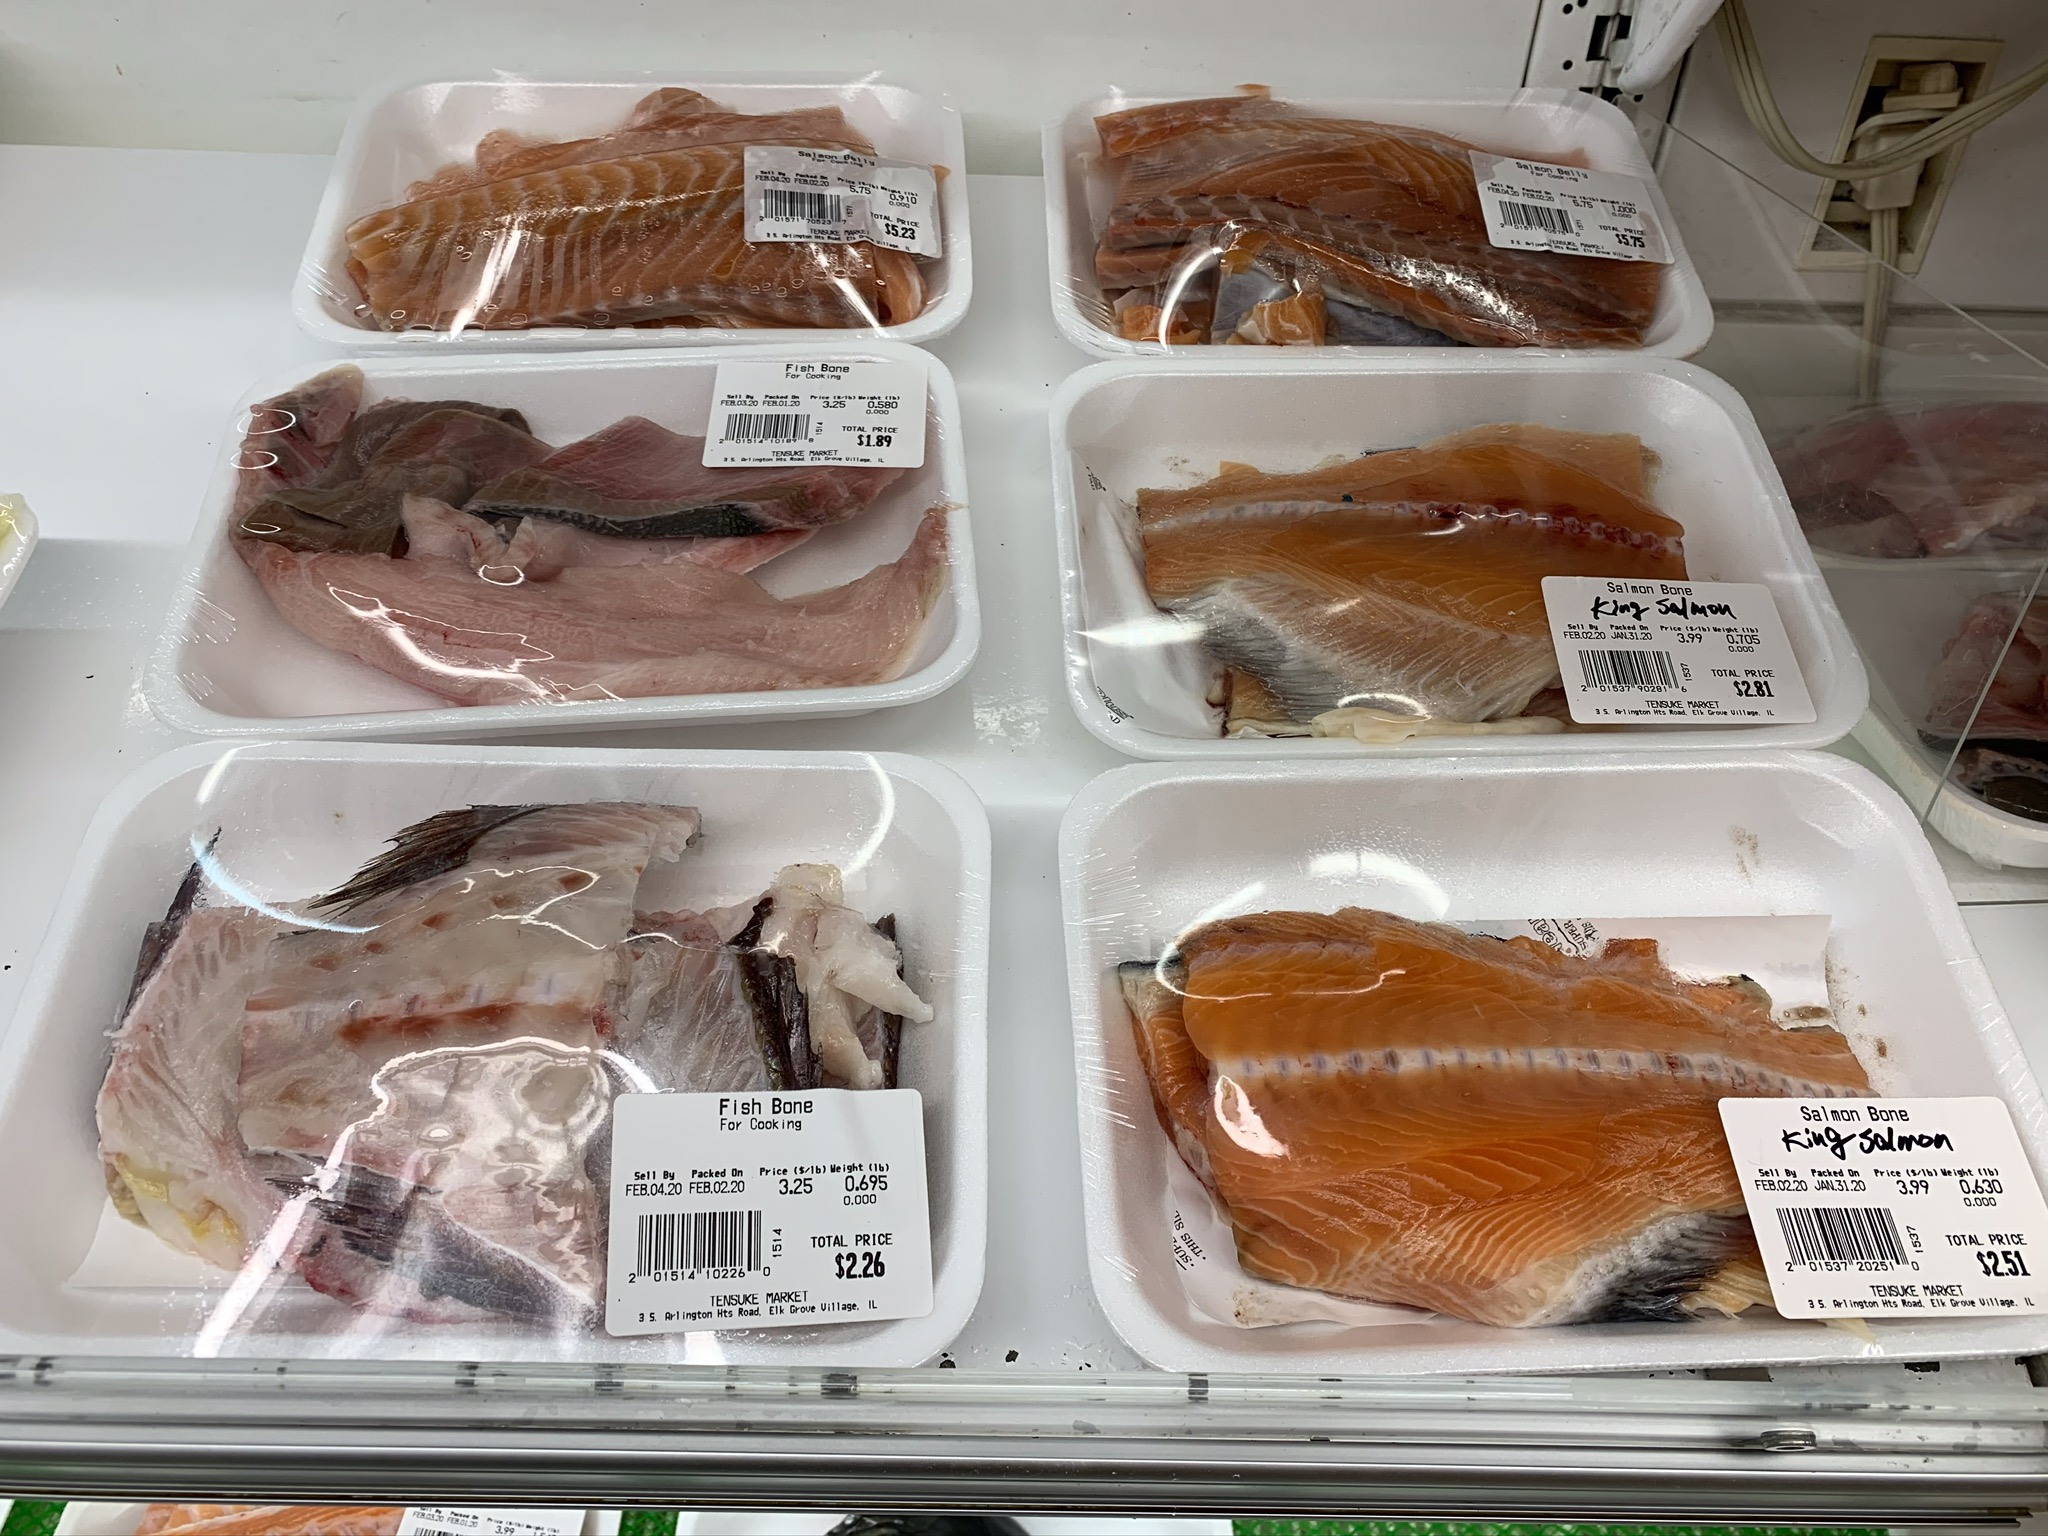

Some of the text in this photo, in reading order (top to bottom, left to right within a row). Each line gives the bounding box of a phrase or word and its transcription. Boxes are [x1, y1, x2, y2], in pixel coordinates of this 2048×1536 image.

[798, 151, 875, 166] Salmon Belly
[1516, 162, 1588, 179] Salmon Belly
[849, 185, 871, 195] 5.75
[889, 194, 917, 205] 0.910
[1572, 200, 1593, 209] 5.75
[1611, 205, 1637, 214] 1.000
[870, 211, 919, 228] TOTAL PRICE
[885, 222, 916, 240] $5.23
[1599, 225, 1647, 236] TOTAL PRICE
[1615, 233, 1646, 248] $5.75
[785, 363, 850, 373] Fish Bone
[822, 400, 846, 408] 3.25
[867, 401, 898, 409] 0.580
[857, 434, 892, 447] $1.89
[1607, 582, 1693, 596] Salmon Bone
[1563, 631, 1653, 640] FEB.02.20 JAN.31.20
[1677, 633, 1702, 643] 3.99
[1726, 634, 1761, 645] 0.705
[1728, 645, 1754, 653] 0.000
[1680, 663, 1692, 681] 1537
[1711, 669, 1775, 678] TOTAL PRICE
[1637, 685, 1667, 693] 90281
[1733, 680, 1775, 697] $2.81
[1645, 700, 1719, 709] TENSUKE MARKET
[719, 1097, 813, 1116] Fish Bone
[1800, 1106, 1909, 1122] Salmon Bone
[720, 1117, 802, 1131] For Cooking
[634, 1171, 656, 1181] Sell
[663, 1170, 675, 1181] By
[692, 1168, 726, 1178] Packed
[731, 1168, 743, 1177] On
[760, 1167, 788, 1176] Price
[830, 1163, 863, 1173] Weight
[869, 1163, 889, 1172] (lb)
[1758, 1168, 1779, 1177] Sell
[1784, 1168, 1797, 1178] By
[1811, 1169, 1844, 1177] Packed
[1847, 1169, 1860, 1177] On
[1873, 1169, 1901, 1177] Price
[1940, 1168, 1974, 1178] Weight
[1978, 1168, 1999, 1176] (lb)
[626, 1180, 745, 1196] FEB.04.20 FEB.02.20
[779, 1178, 813, 1195] 3.25
[845, 1174, 888, 1192] 0.695
[1754, 1179, 1866, 1192] FEB.02.20 JAN.31.20
[1896, 1180, 1929, 1195] 3.99
[1959, 1179, 2003, 1194] 0.630
[843, 1194, 877, 1206] 0.000
[1963, 1197, 1997, 1207] 0.000
[772, 1228, 782, 1258] 1514
[810, 1233, 893, 1248] TOTAL PRICE
[1180, 1232, 1203, 1257] THIS
[1906, 1225, 1924, 1253] 1537
[1945, 1234, 2027, 1246] TOTAL PRICE
[835, 1251, 885, 1279] $2.26
[1785, 1261, 1920, 1272] 2 01537 20251 0
[1976, 1250, 2031, 1277] $2.51
[628, 1266, 771, 1283] 2 01514 10226 0
[1869, 1285, 1963, 1297] TENSUKE MARKET
[710, 1290, 808, 1307] TENSUKE MARKET
[639, 1313, 644, 1322] 3
[665, 1311, 713, 1321] Arlington
[717, 1309, 733, 1318] Hts
[769, 1305, 784, 1315] Elk
[790, 1305, 816, 1314] Grove
[868, 1300, 878, 1309] IL
[495, 1525, 515, 1536] 3.99
